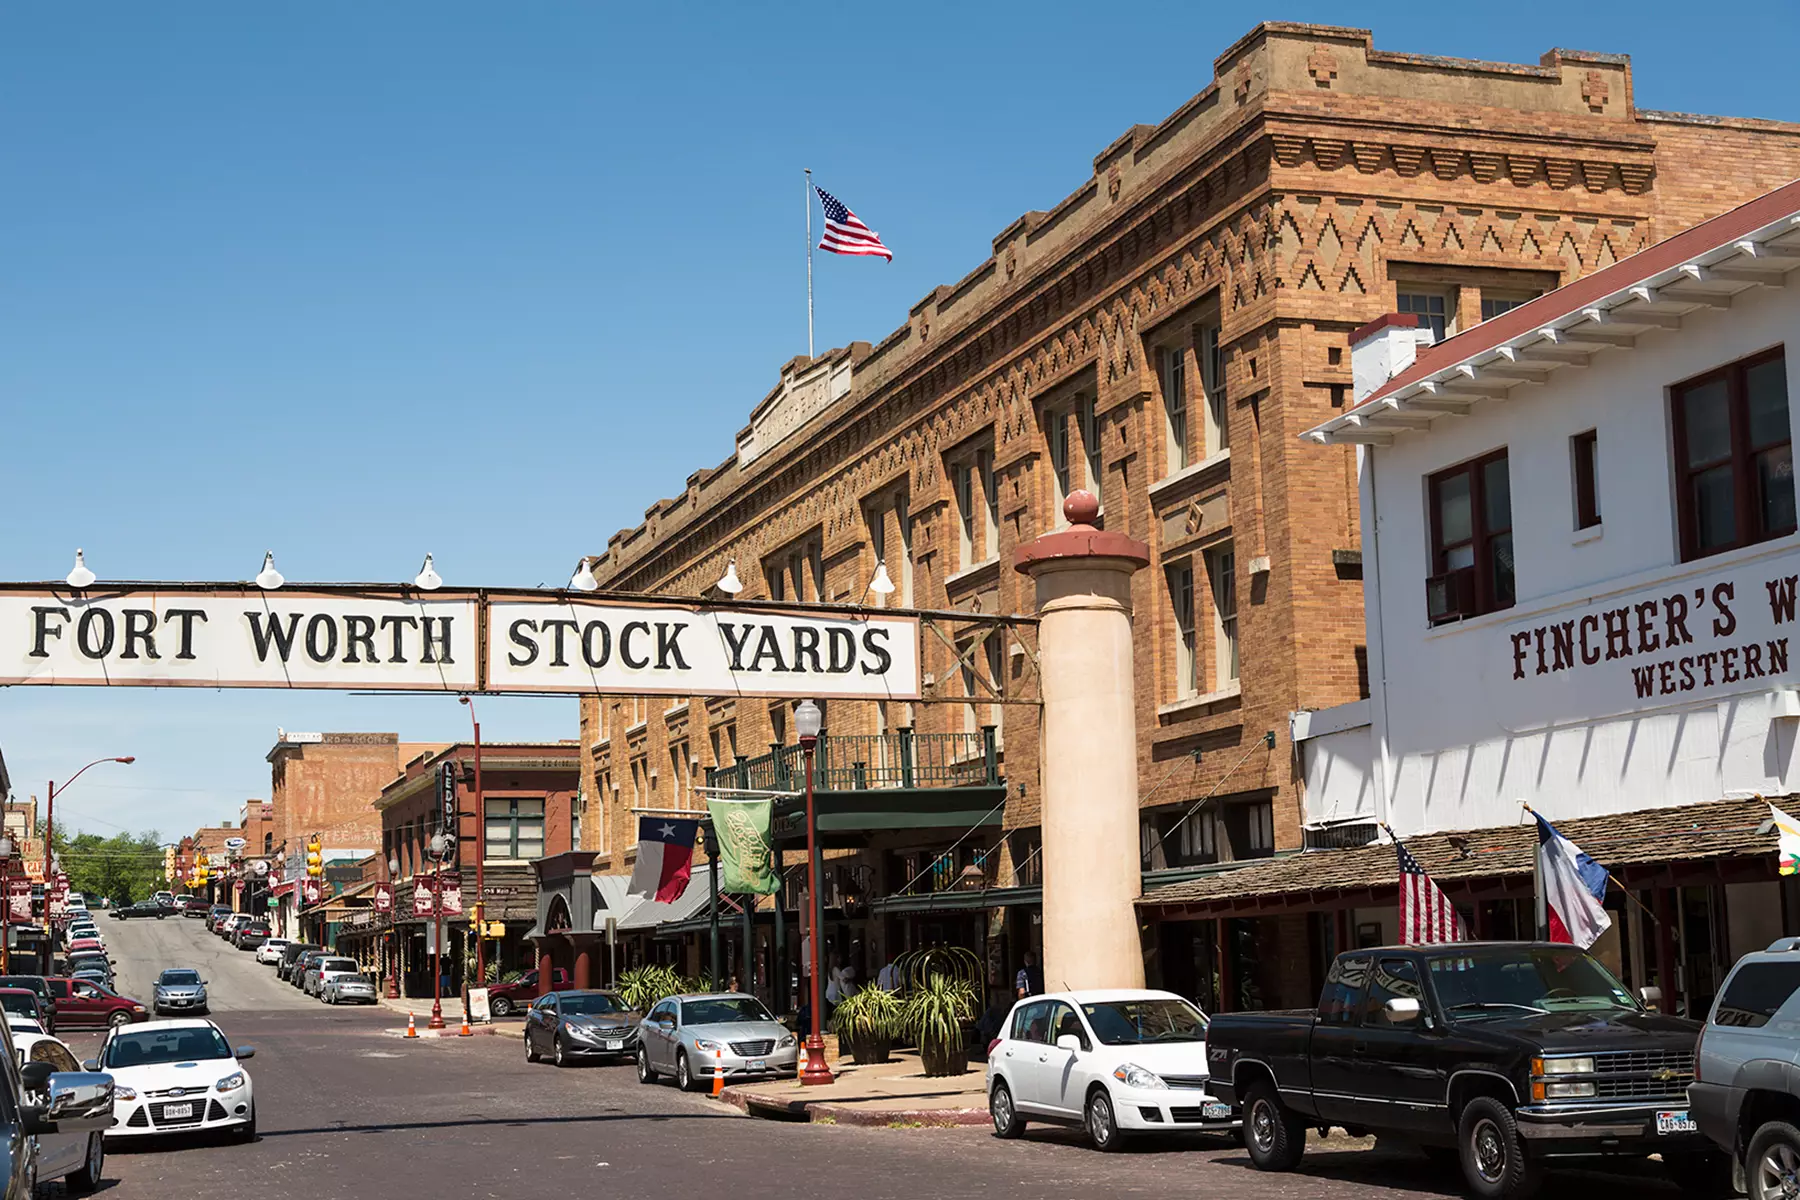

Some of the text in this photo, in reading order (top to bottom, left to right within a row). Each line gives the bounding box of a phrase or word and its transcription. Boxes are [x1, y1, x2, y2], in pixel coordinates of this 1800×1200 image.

[29, 606, 892, 675] FORT WORTH STOCK YARDS
[1510, 581, 1737, 681] FINCHER'S
[1631, 637, 1790, 700] WESTERN
[445, 764, 454, 827] LEDDY
